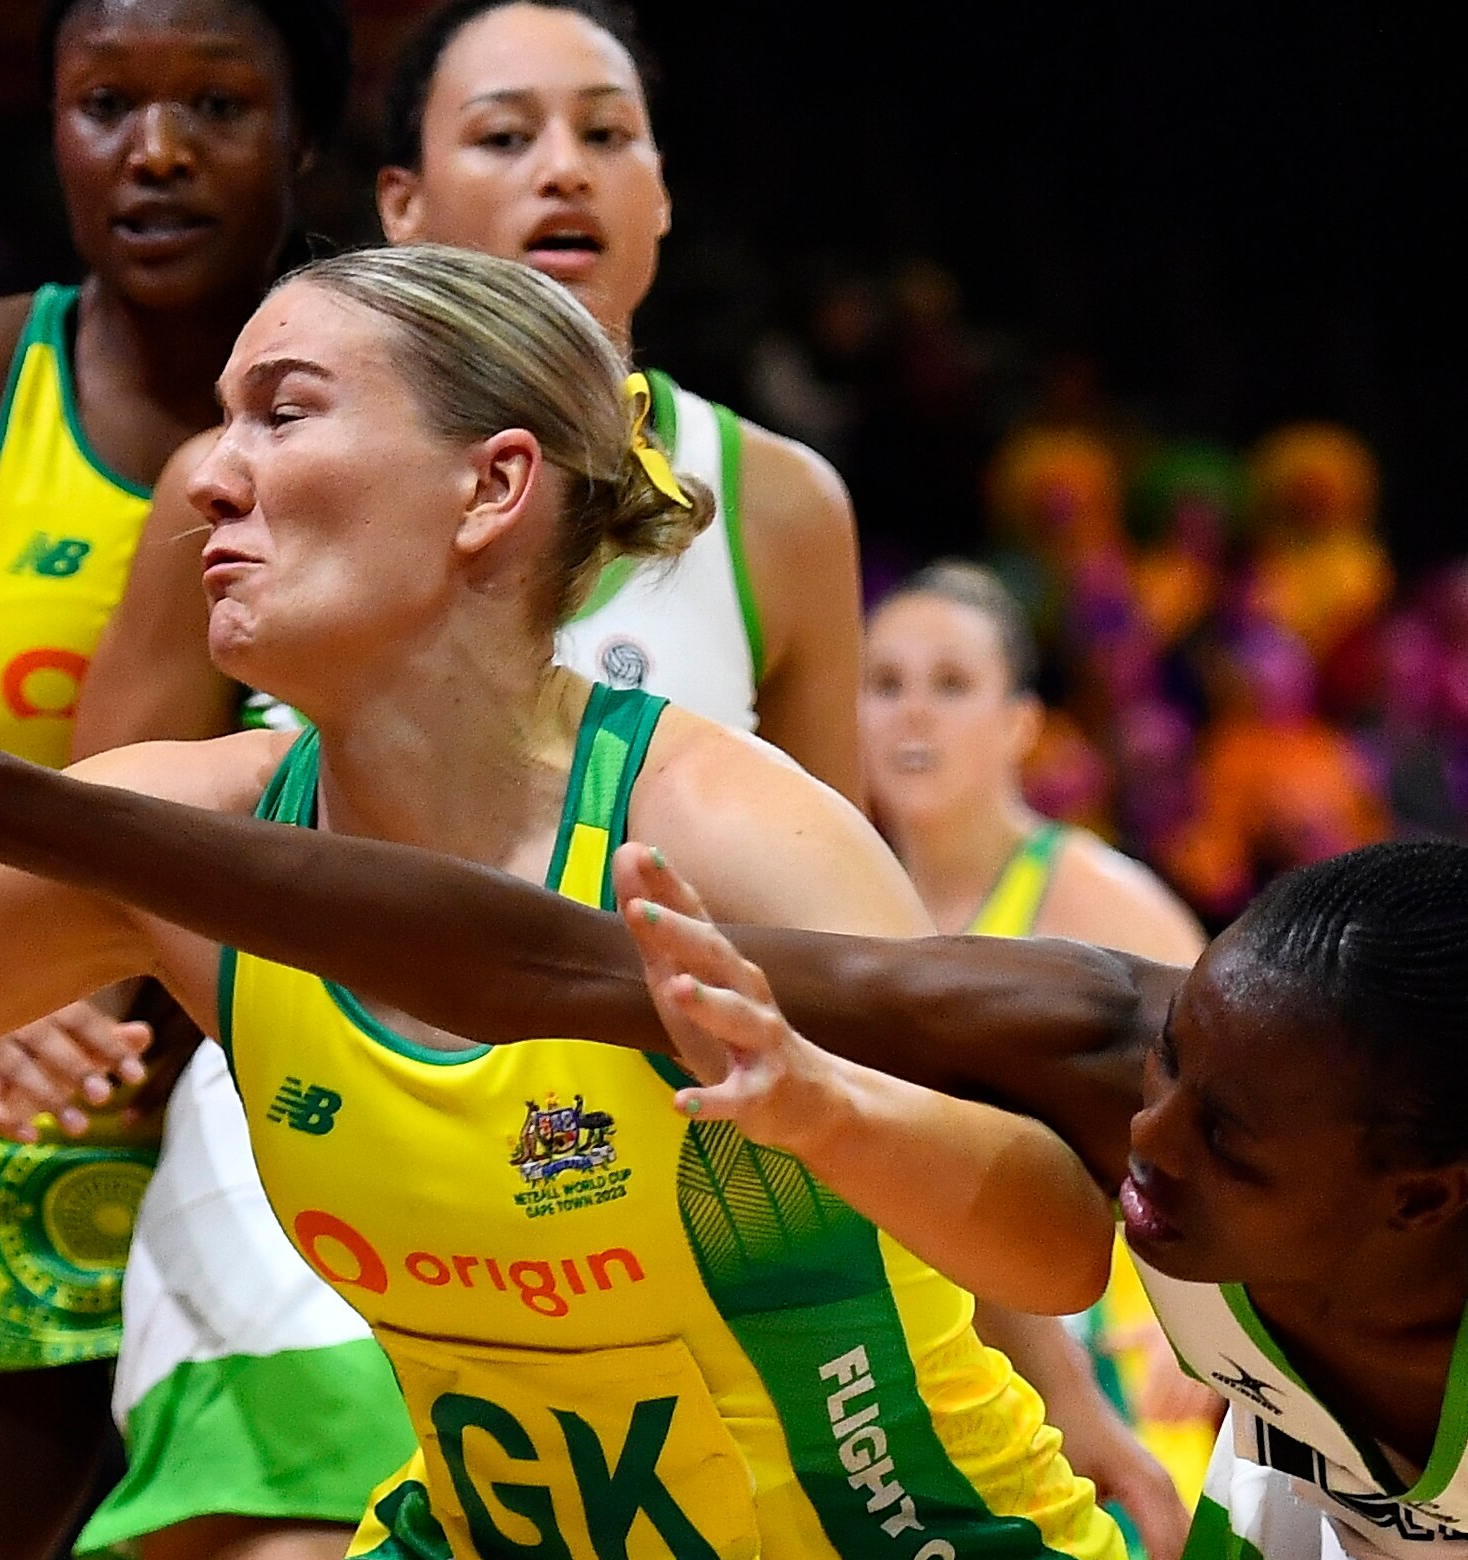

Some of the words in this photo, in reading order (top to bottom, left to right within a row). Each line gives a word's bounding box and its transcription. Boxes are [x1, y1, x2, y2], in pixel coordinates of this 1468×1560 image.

[266, 1076, 342, 1136] NB
[526, 1203, 555, 1218] CAPE
[558, 1196, 594, 1212] TOWN
[563, 1175, 606, 1194] WORLD
[405, 1247, 645, 1317] origin
[818, 1344, 925, 1539] FLIGHT
